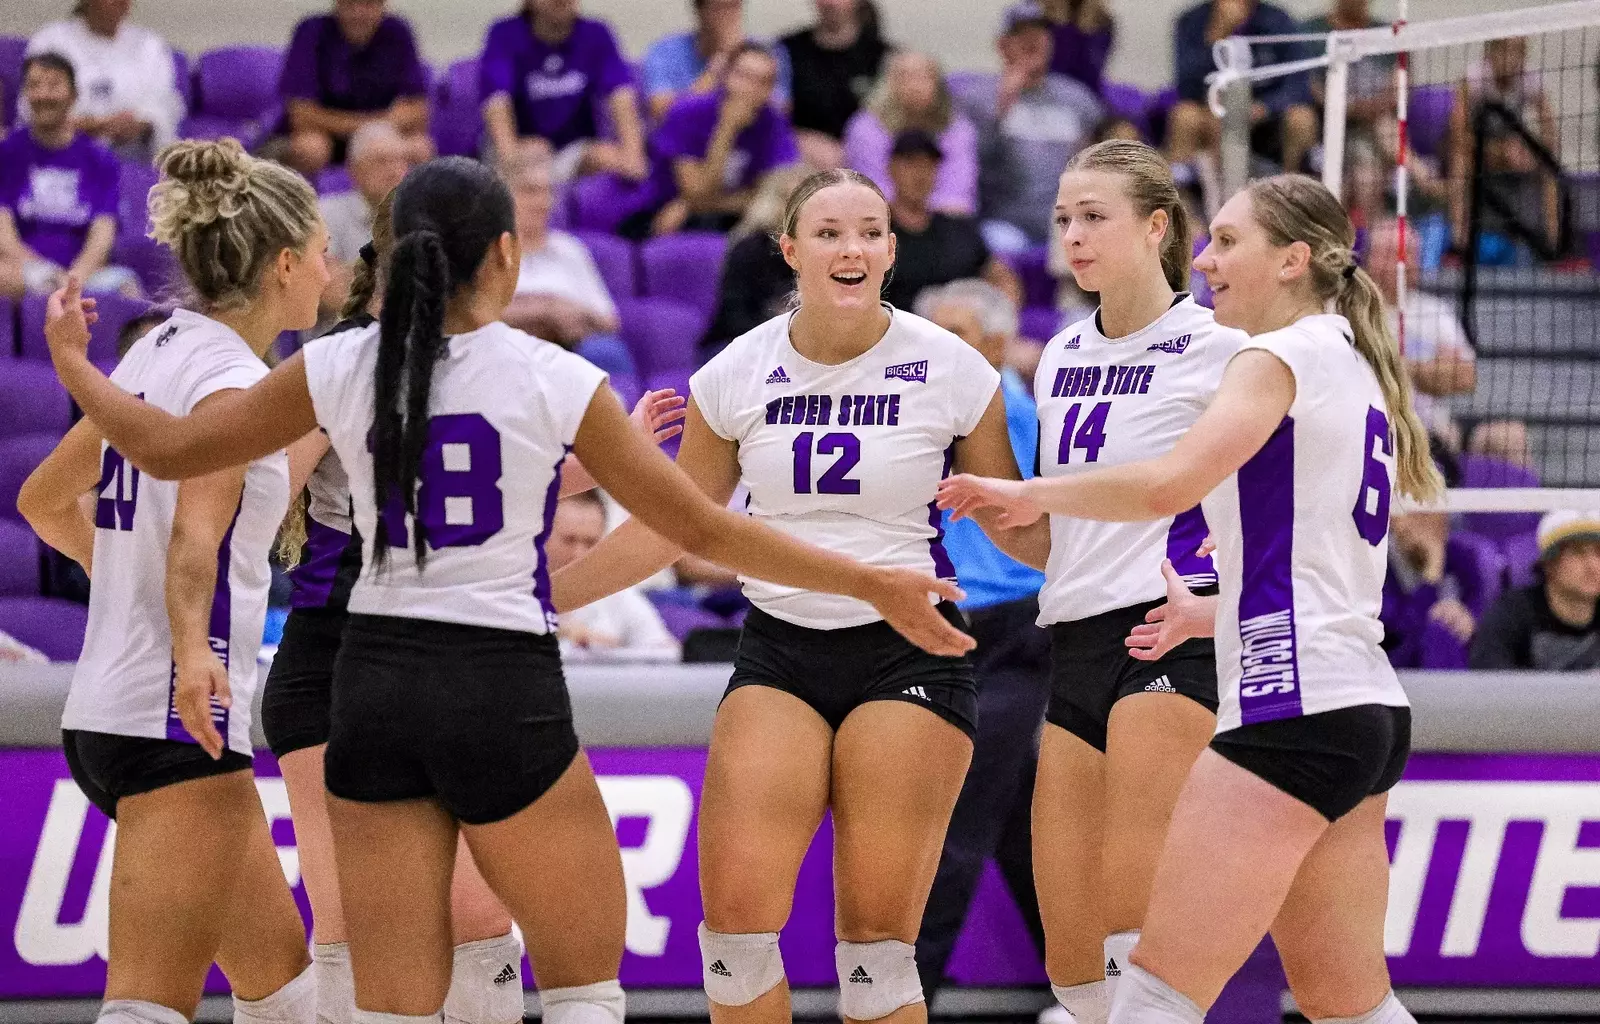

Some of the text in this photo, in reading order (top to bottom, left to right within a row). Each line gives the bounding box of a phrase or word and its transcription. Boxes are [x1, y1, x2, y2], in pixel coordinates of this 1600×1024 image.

[765, 376, 791, 385] adidas
[1102, 365, 1156, 396] STATE
[765, 394, 901, 426] WEBER STATE
[1058, 401, 1112, 464] 14
[792, 432, 860, 494] 12
[1352, 404, 1393, 547] 6
[1240, 609, 1294, 697] WILDCATS
[1144, 684, 1176, 693] adidas
